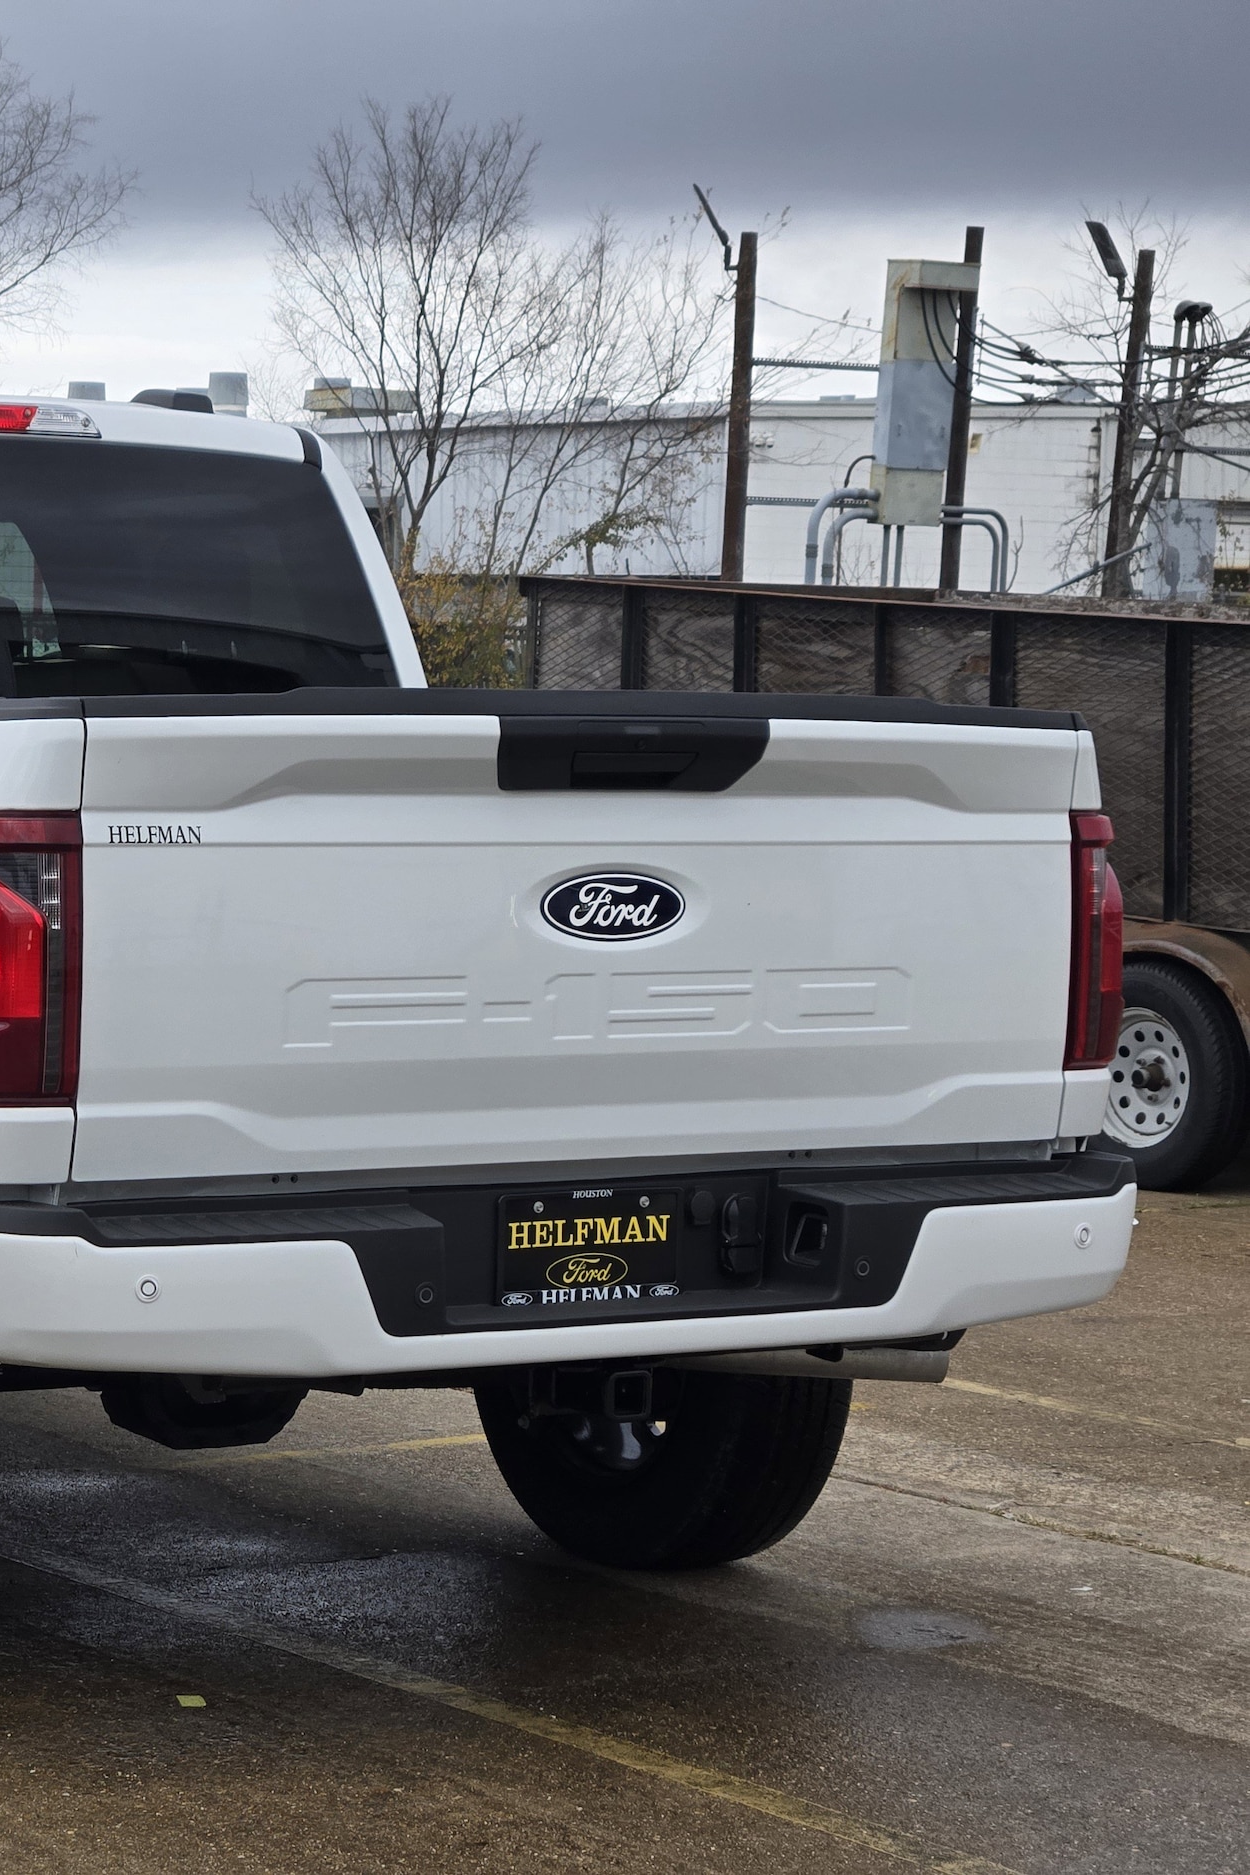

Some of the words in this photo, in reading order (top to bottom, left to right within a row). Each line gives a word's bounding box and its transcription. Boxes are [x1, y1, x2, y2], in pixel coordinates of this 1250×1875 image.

[107, 824, 203, 845] HELFMAN
[568, 882, 660, 929] Ford
[282, 966, 913, 1049] F-150
[572, 1189, 614, 1200] HOUSTON
[507, 1214, 671, 1250] HELFMAN
[562, 1257, 613, 1284] Ford
[654, 1286, 674, 1297] Ford
